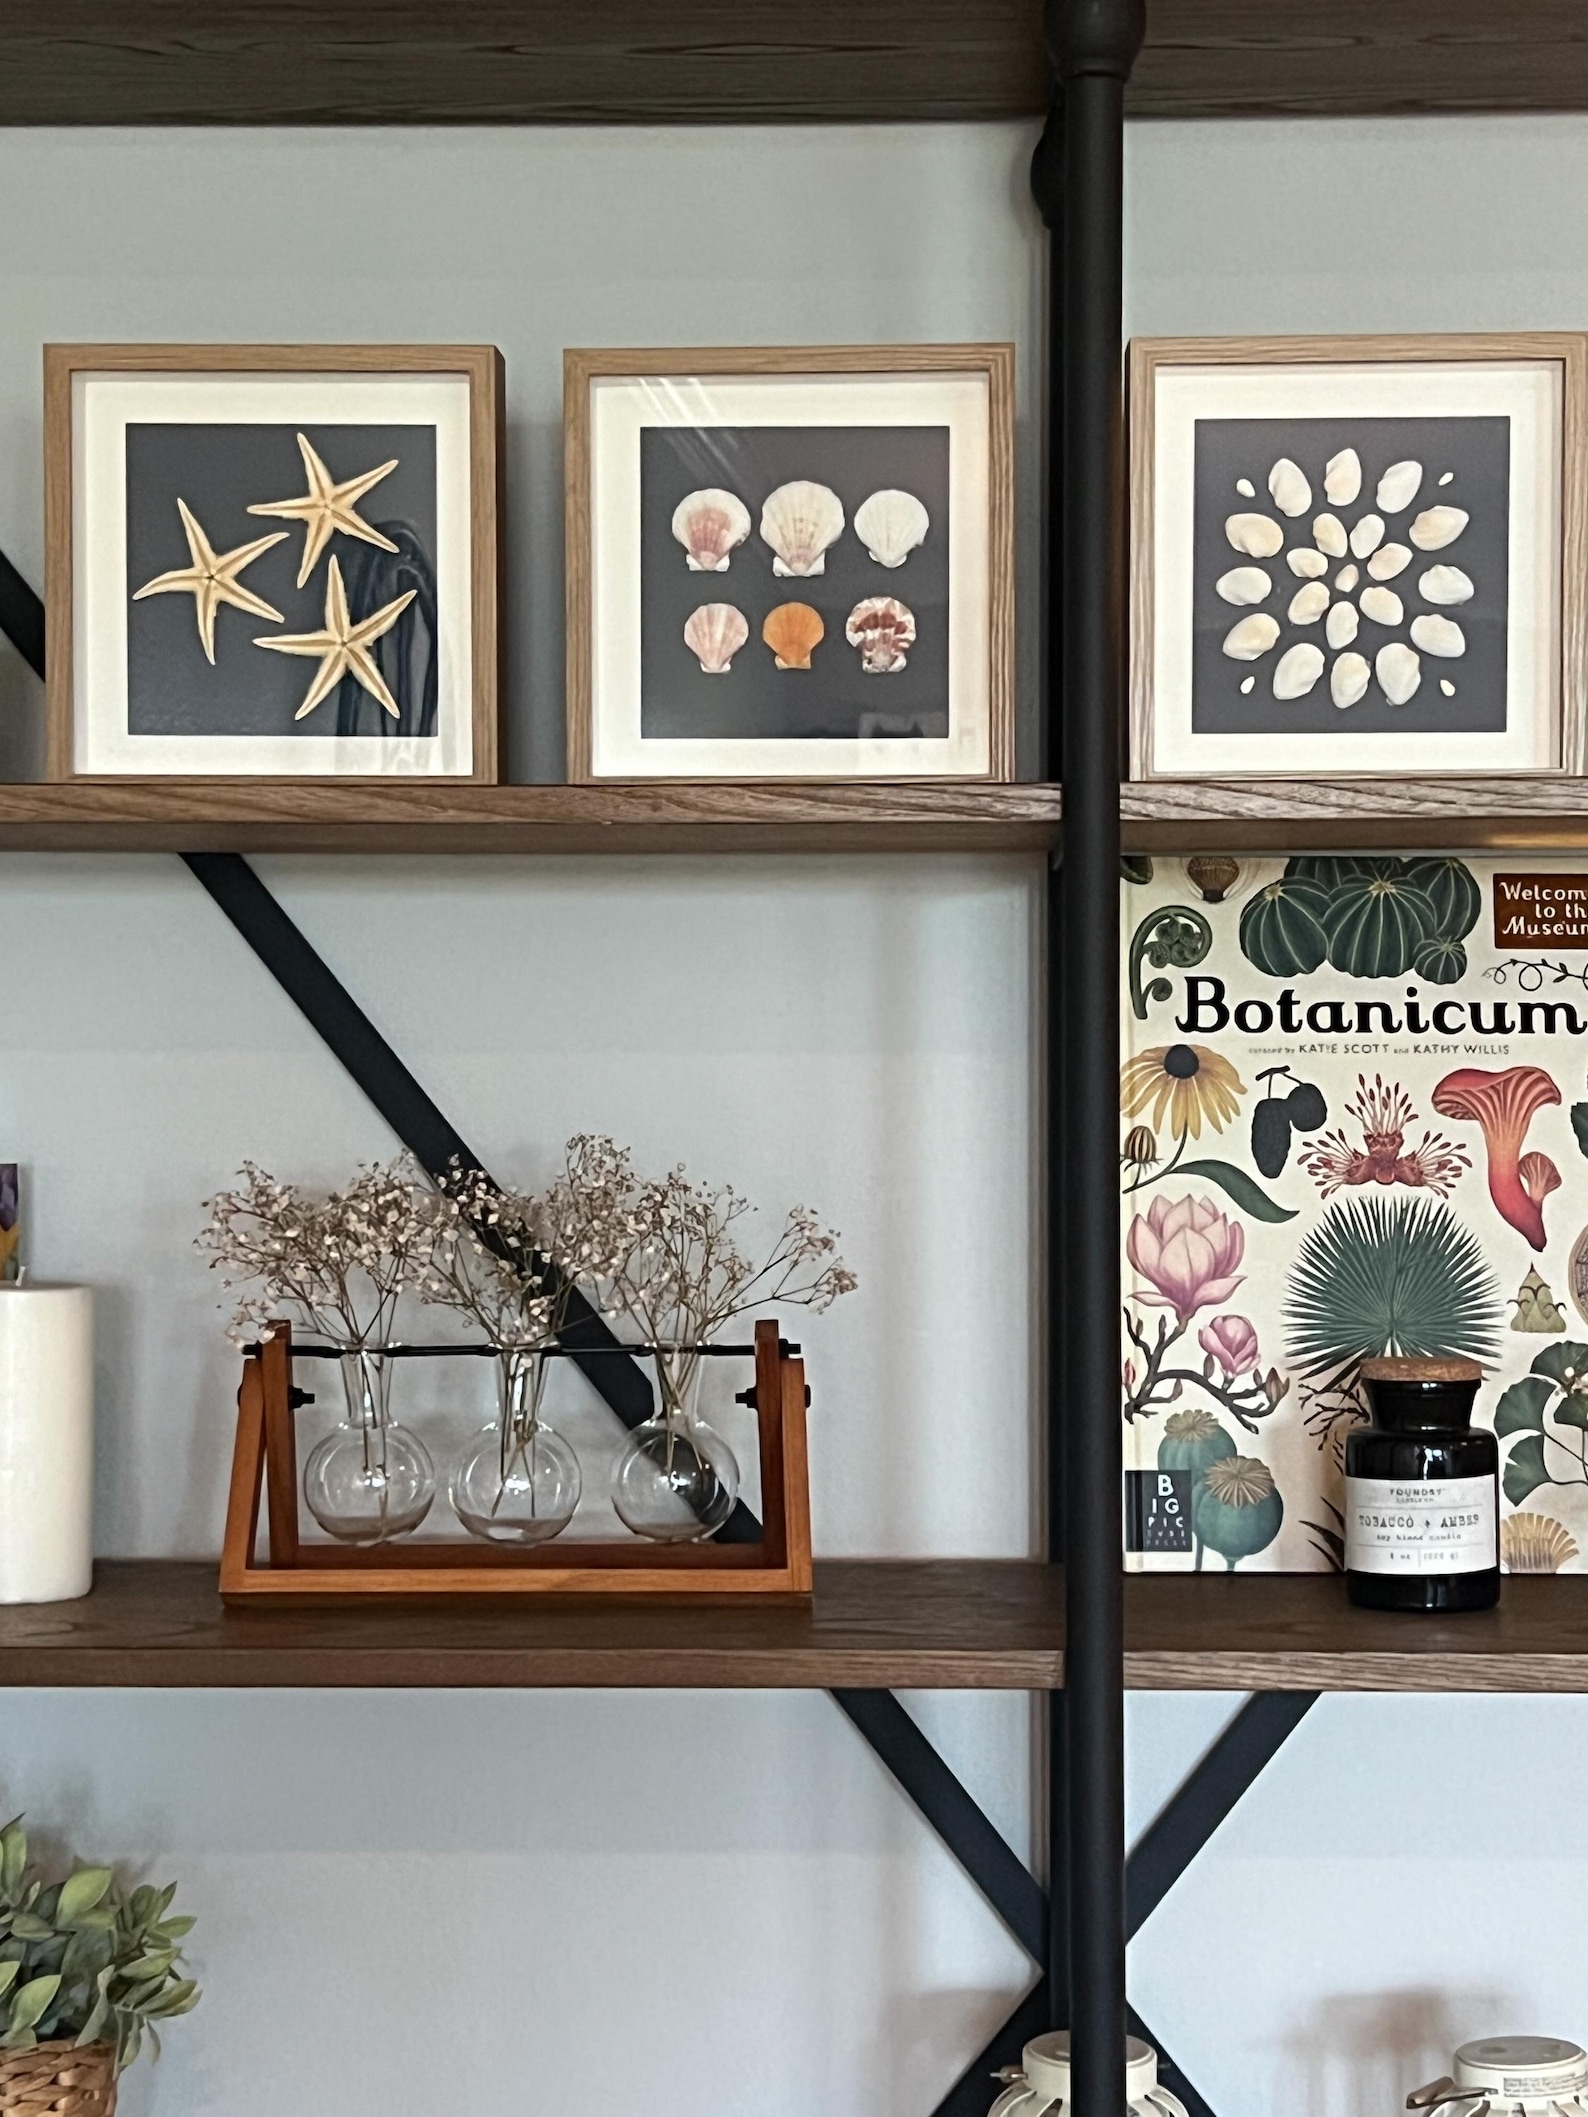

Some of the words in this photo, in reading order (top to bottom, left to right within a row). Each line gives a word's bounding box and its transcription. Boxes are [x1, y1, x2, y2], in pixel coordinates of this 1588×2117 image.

[1499, 881, 1588, 901] Welcom
[1535, 903, 1556, 919] to
[1565, 903, 1588, 919] th
[1174, 976, 1588, 1035] Botanicum
[1299, 1043, 1338, 1054] KATIE
[1343, 1043, 1389, 1054] SCOTT
[1413, 1044, 1459, 1054] KATHY
[1464, 1044, 1509, 1055] WILLIS
[1359, 1514, 1414, 1528] TOBACCO
